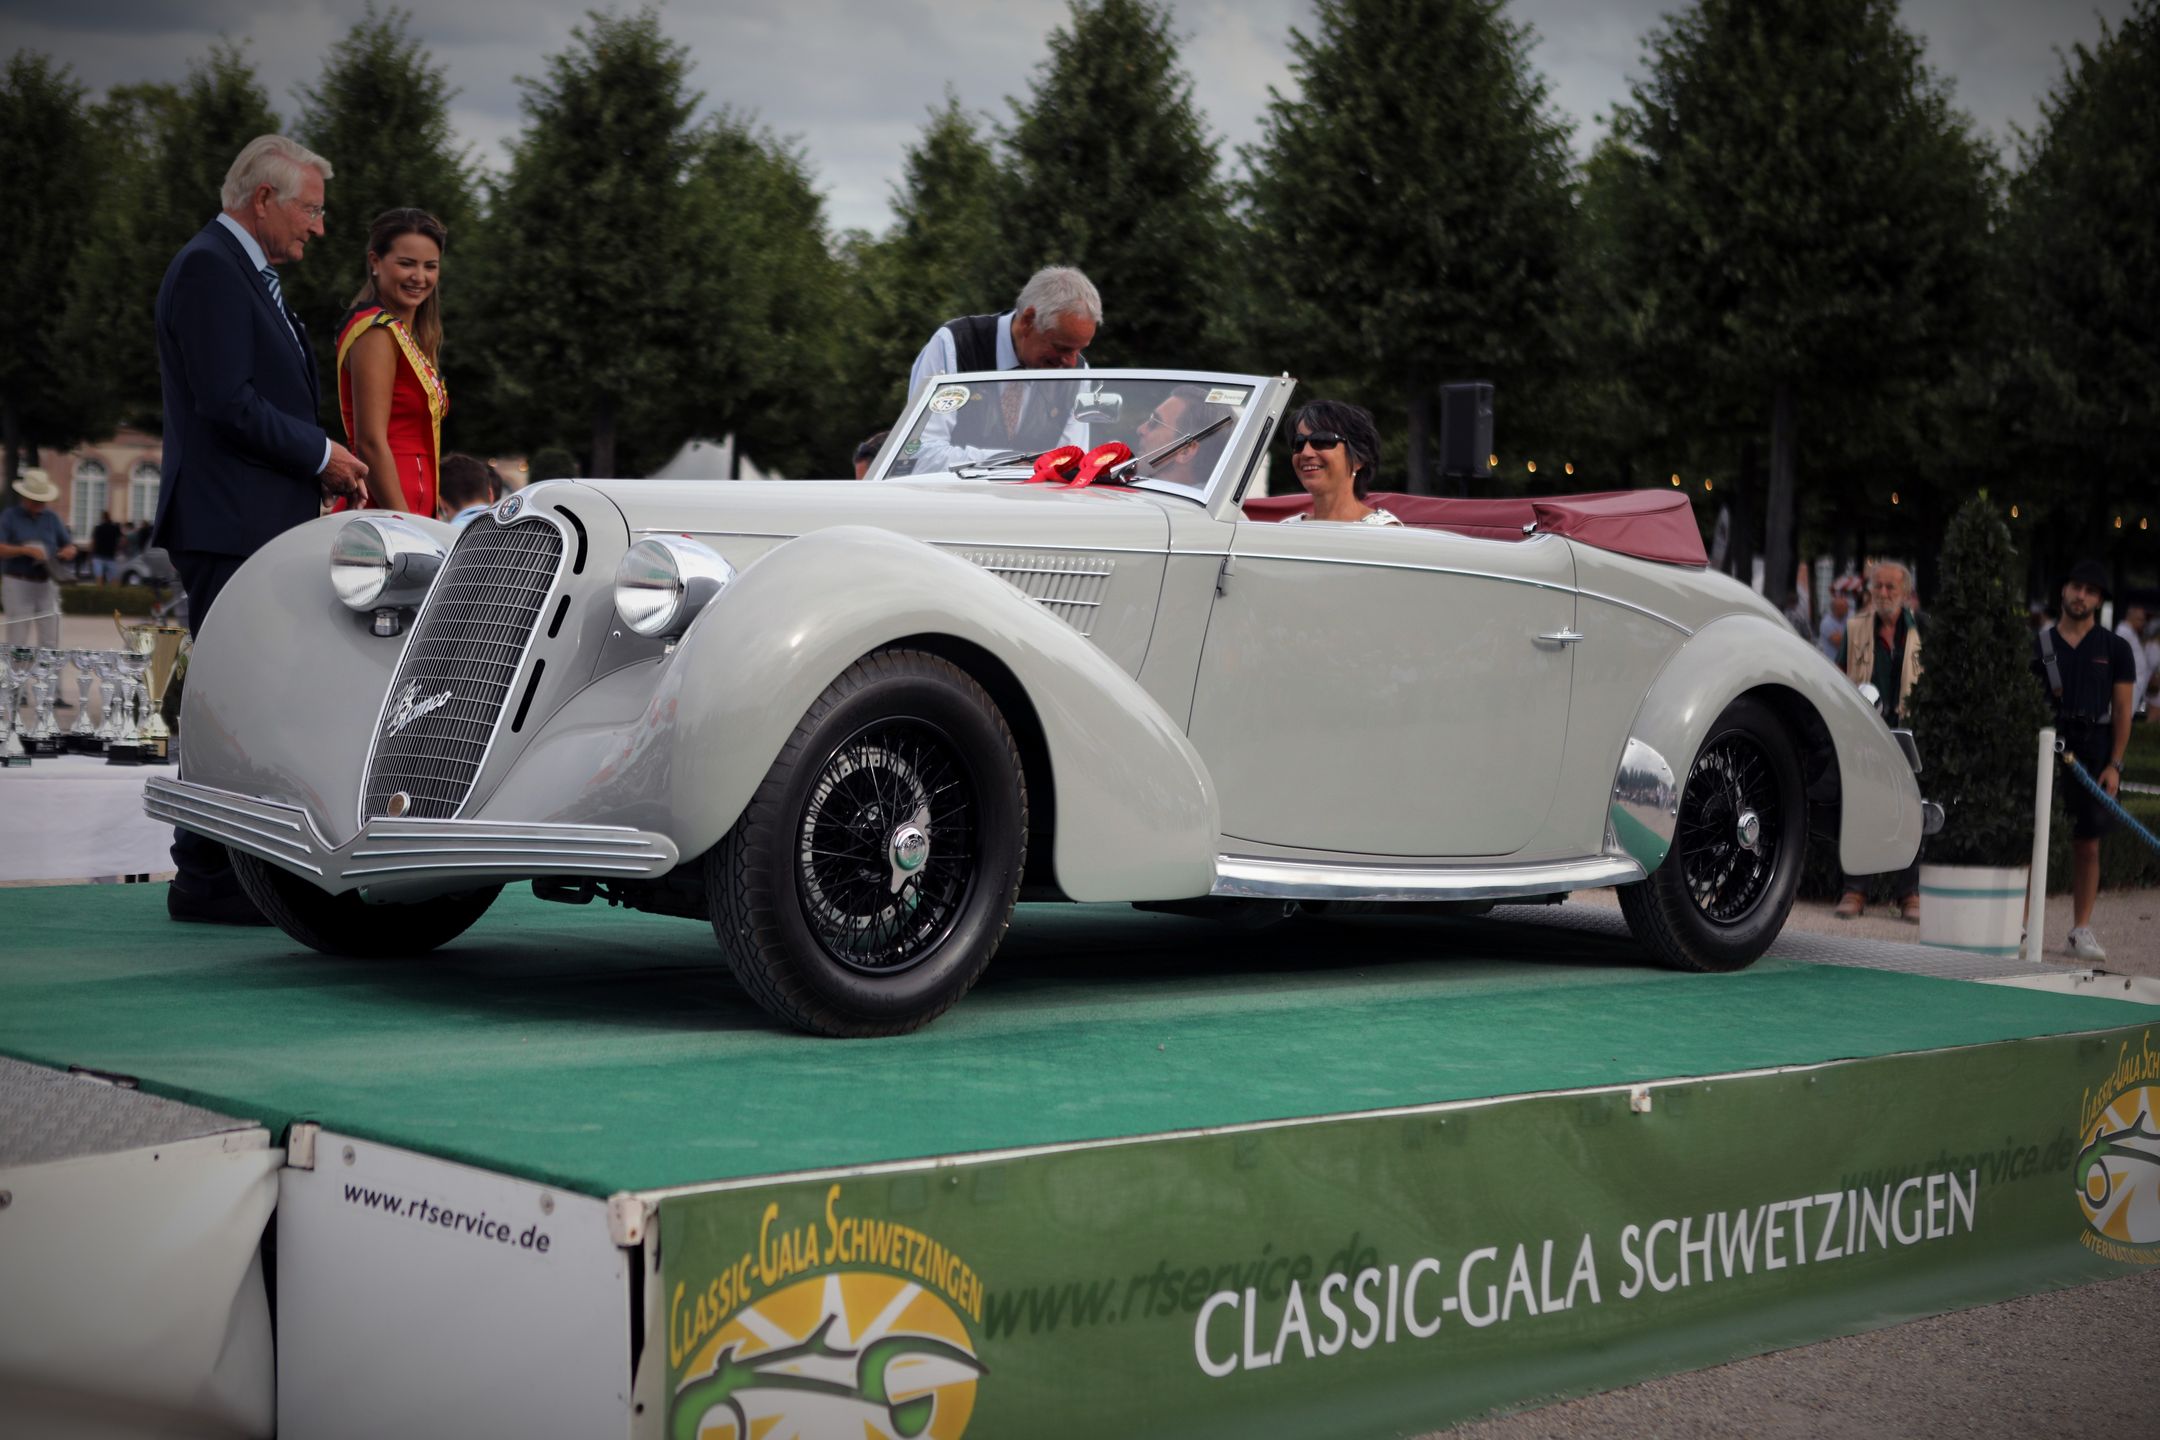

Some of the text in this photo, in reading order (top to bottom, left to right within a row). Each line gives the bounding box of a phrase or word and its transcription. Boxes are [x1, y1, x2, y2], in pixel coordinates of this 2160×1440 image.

[344, 1183, 551, 1253] www.rtservice.de
[1194, 1169, 1978, 1378] CLASSIC-GALA SCHWETZINGEN
